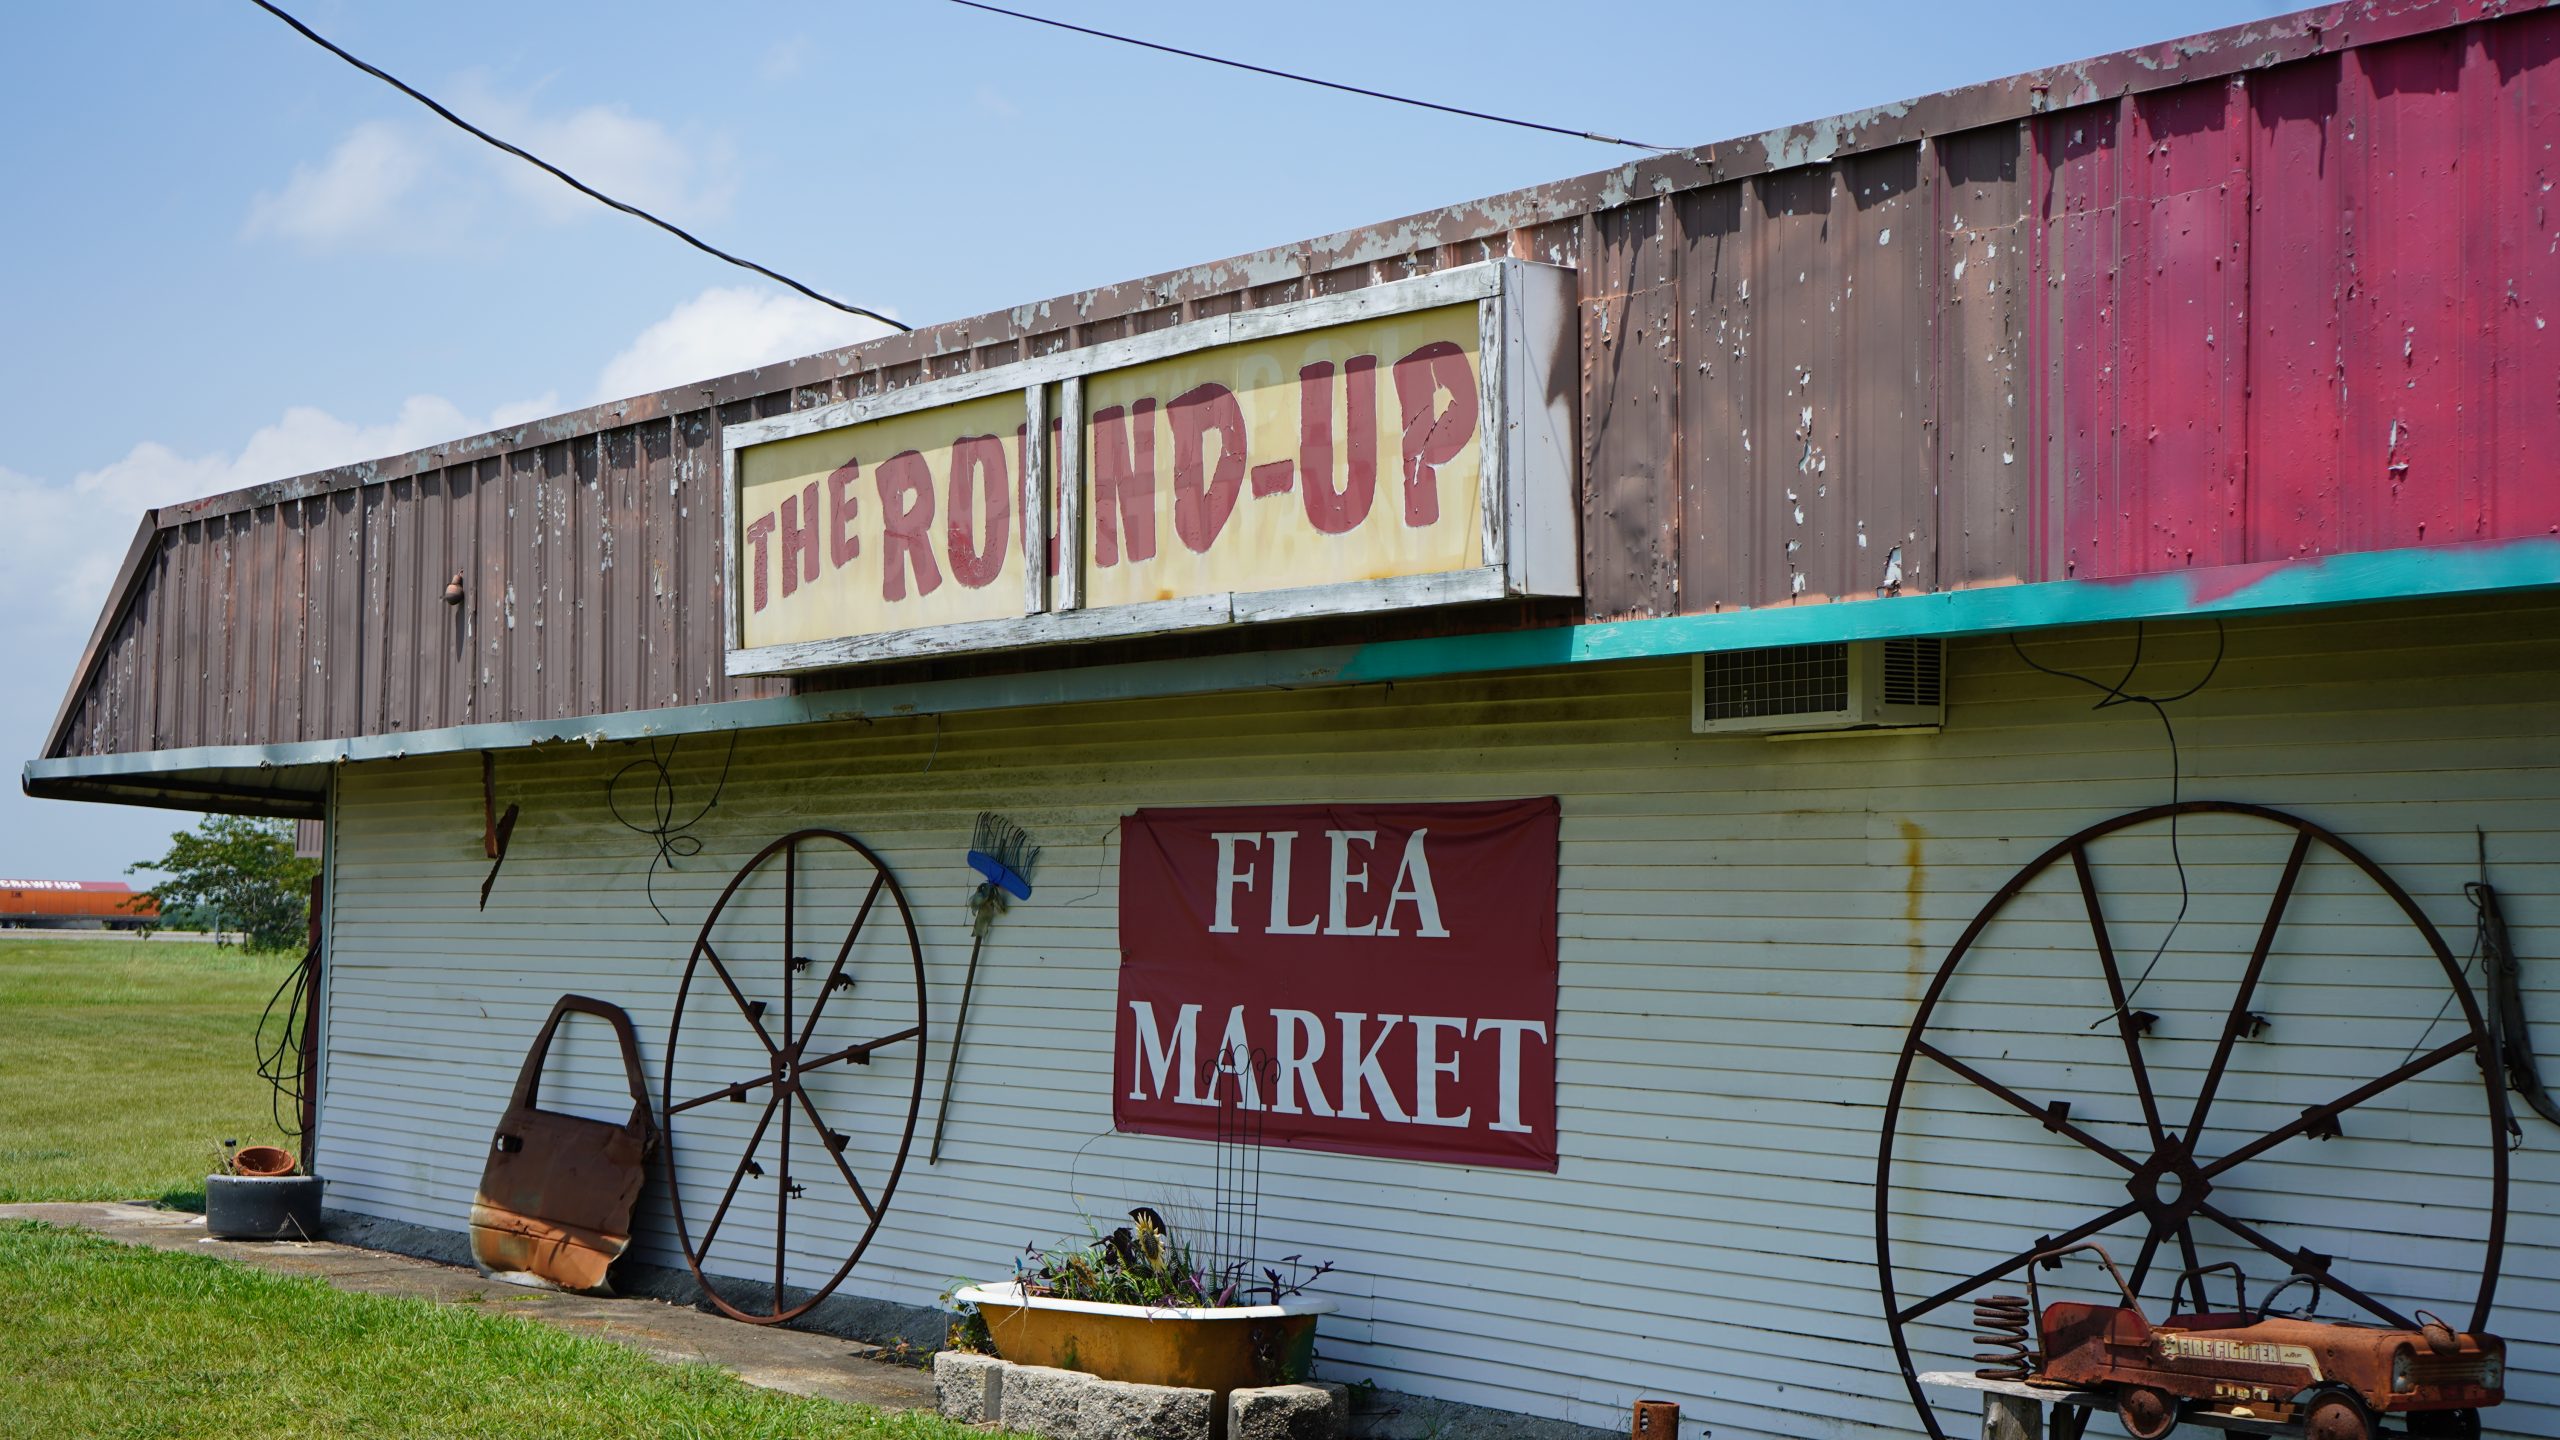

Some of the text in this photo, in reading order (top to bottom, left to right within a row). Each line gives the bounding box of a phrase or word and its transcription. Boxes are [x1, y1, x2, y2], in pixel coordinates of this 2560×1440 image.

[747, 457, 860, 614] THE
[1208, 828, 1450, 938] FLEA
[1129, 1001, 1547, 1133] MARKET
[2179, 1338, 2279, 1363] FIRE FIGHTER
